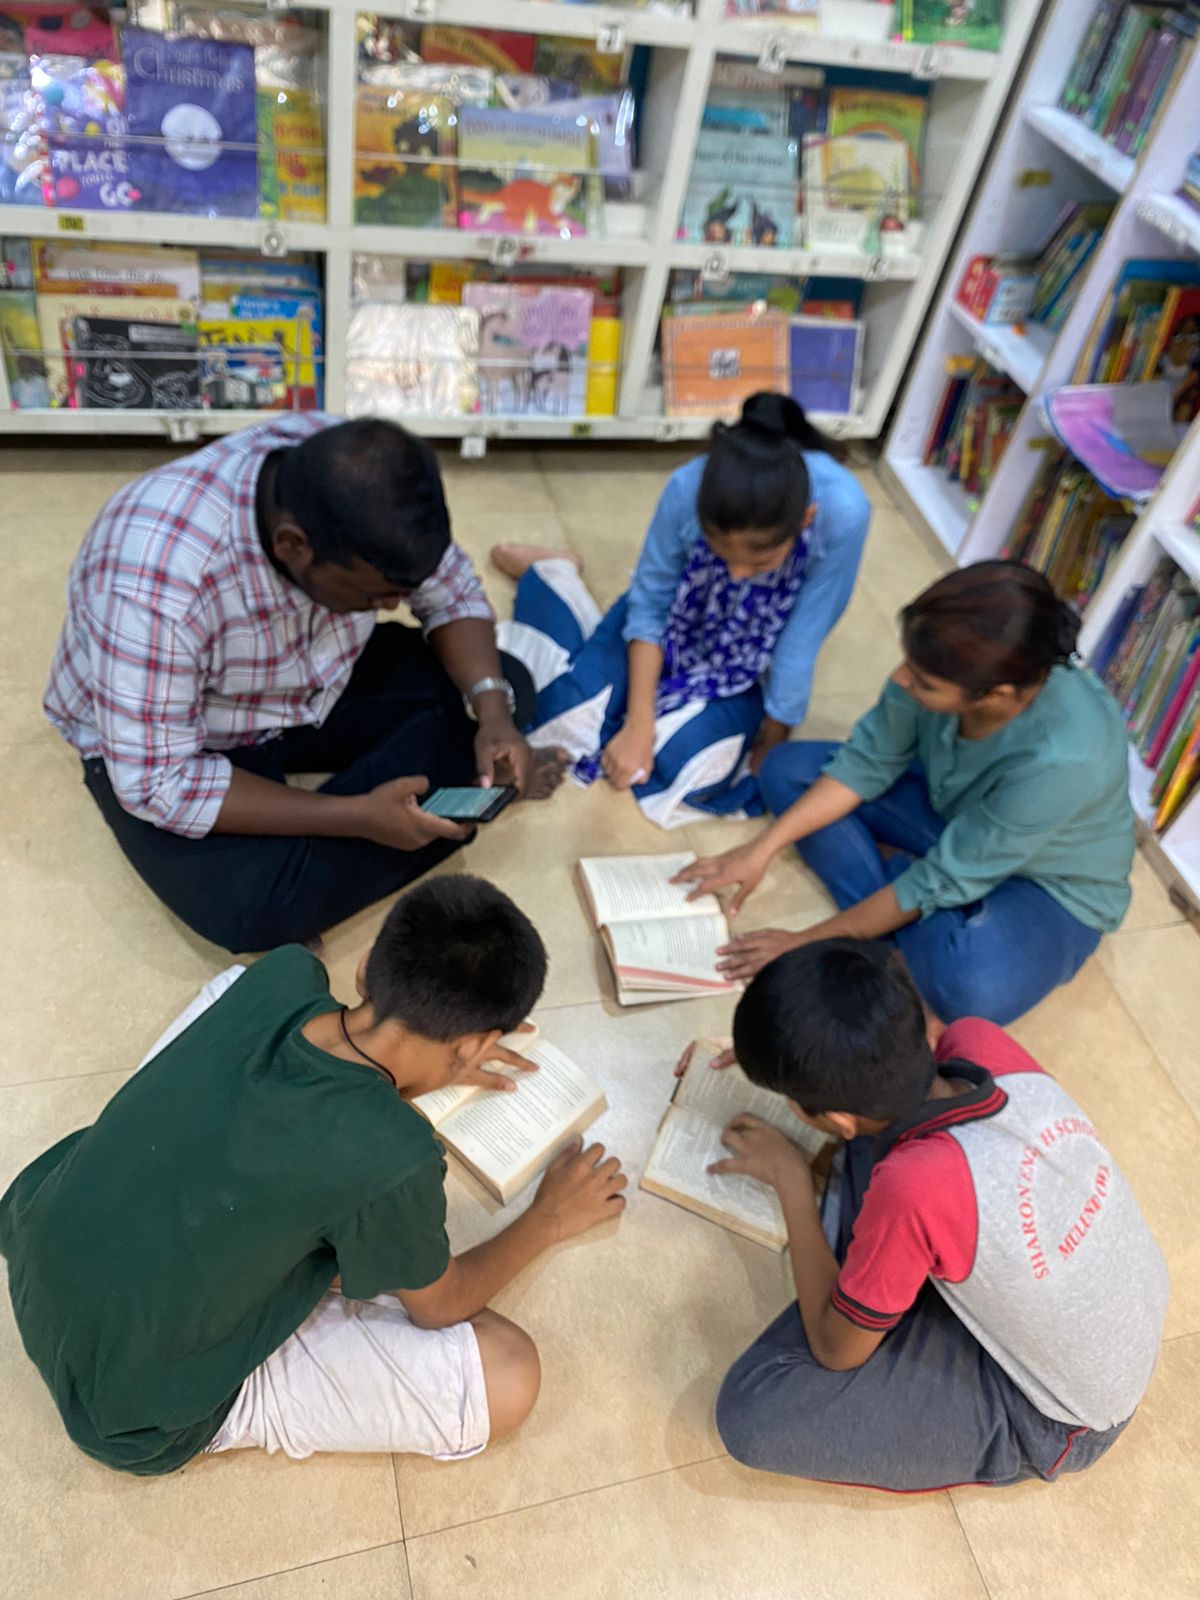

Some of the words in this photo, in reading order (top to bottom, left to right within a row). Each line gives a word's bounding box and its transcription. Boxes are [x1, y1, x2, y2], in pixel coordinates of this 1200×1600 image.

[133, 46, 245, 90] Christmas
[1017, 1183, 1050, 1280] SHARON
[1053, 1117, 1101, 1143] SCHO
